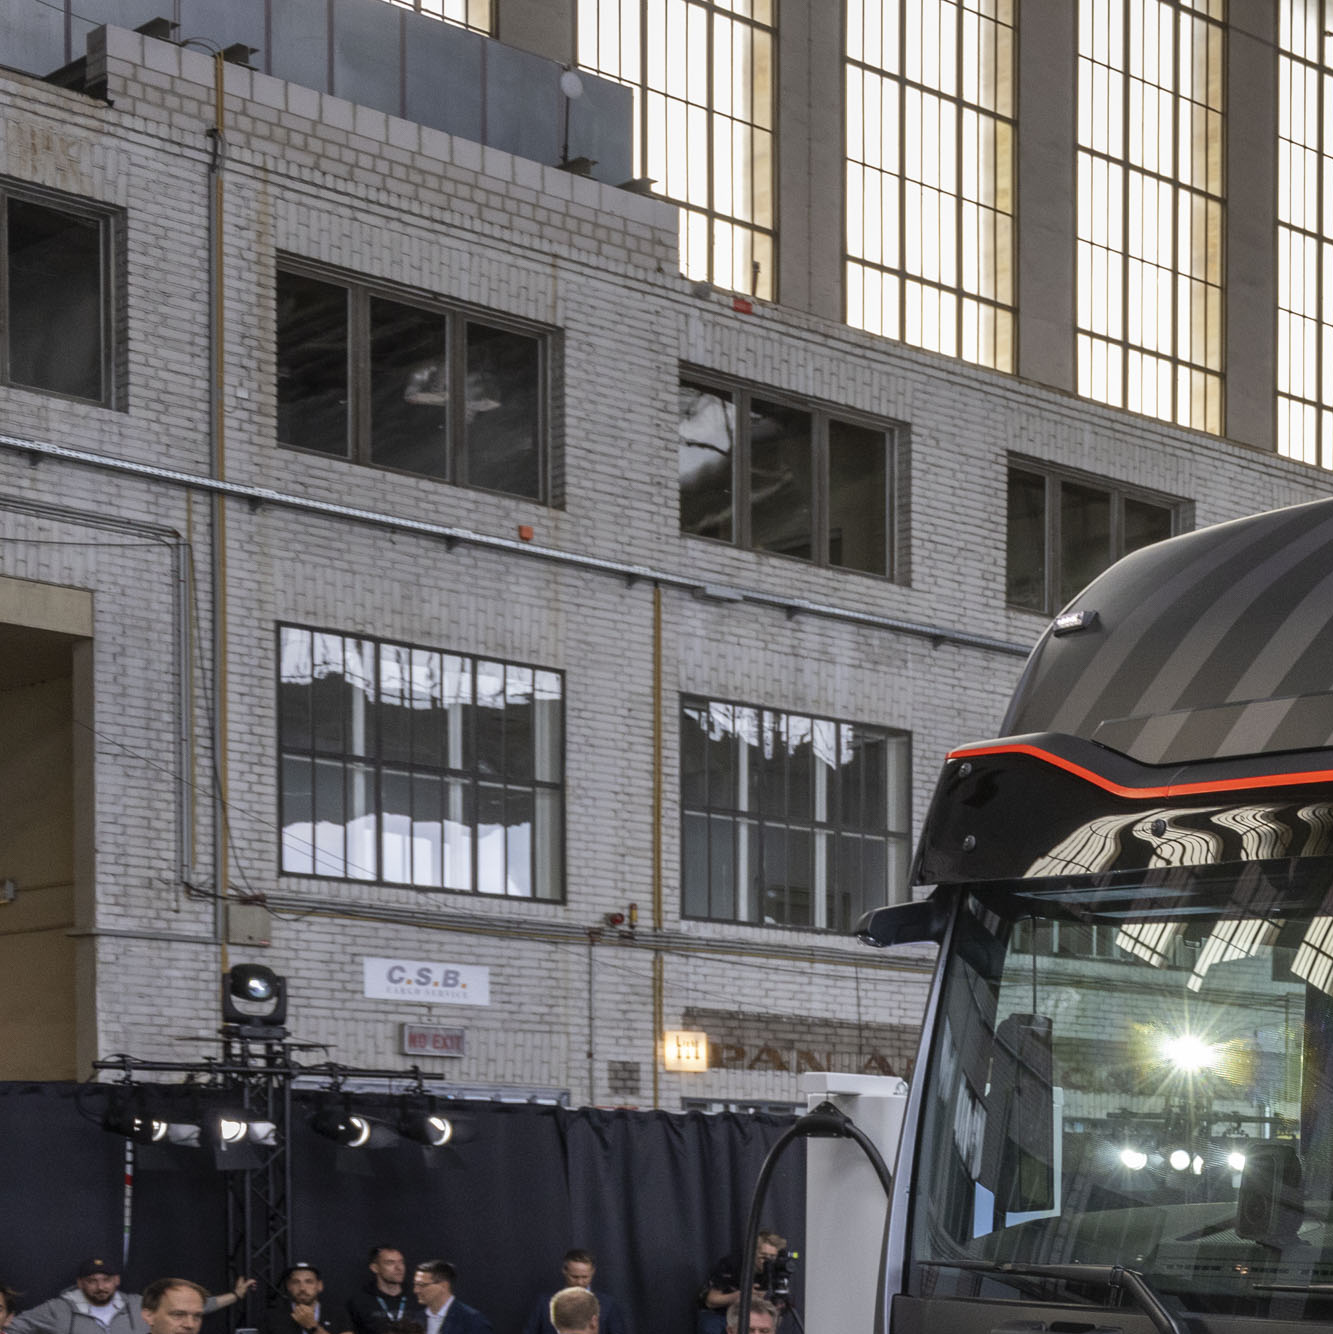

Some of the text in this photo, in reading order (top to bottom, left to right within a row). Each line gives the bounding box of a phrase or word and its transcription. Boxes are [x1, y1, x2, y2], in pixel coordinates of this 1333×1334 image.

[386, 965, 468, 989] C.S.B.
[408, 1033, 464, 1051] NO EXIT
